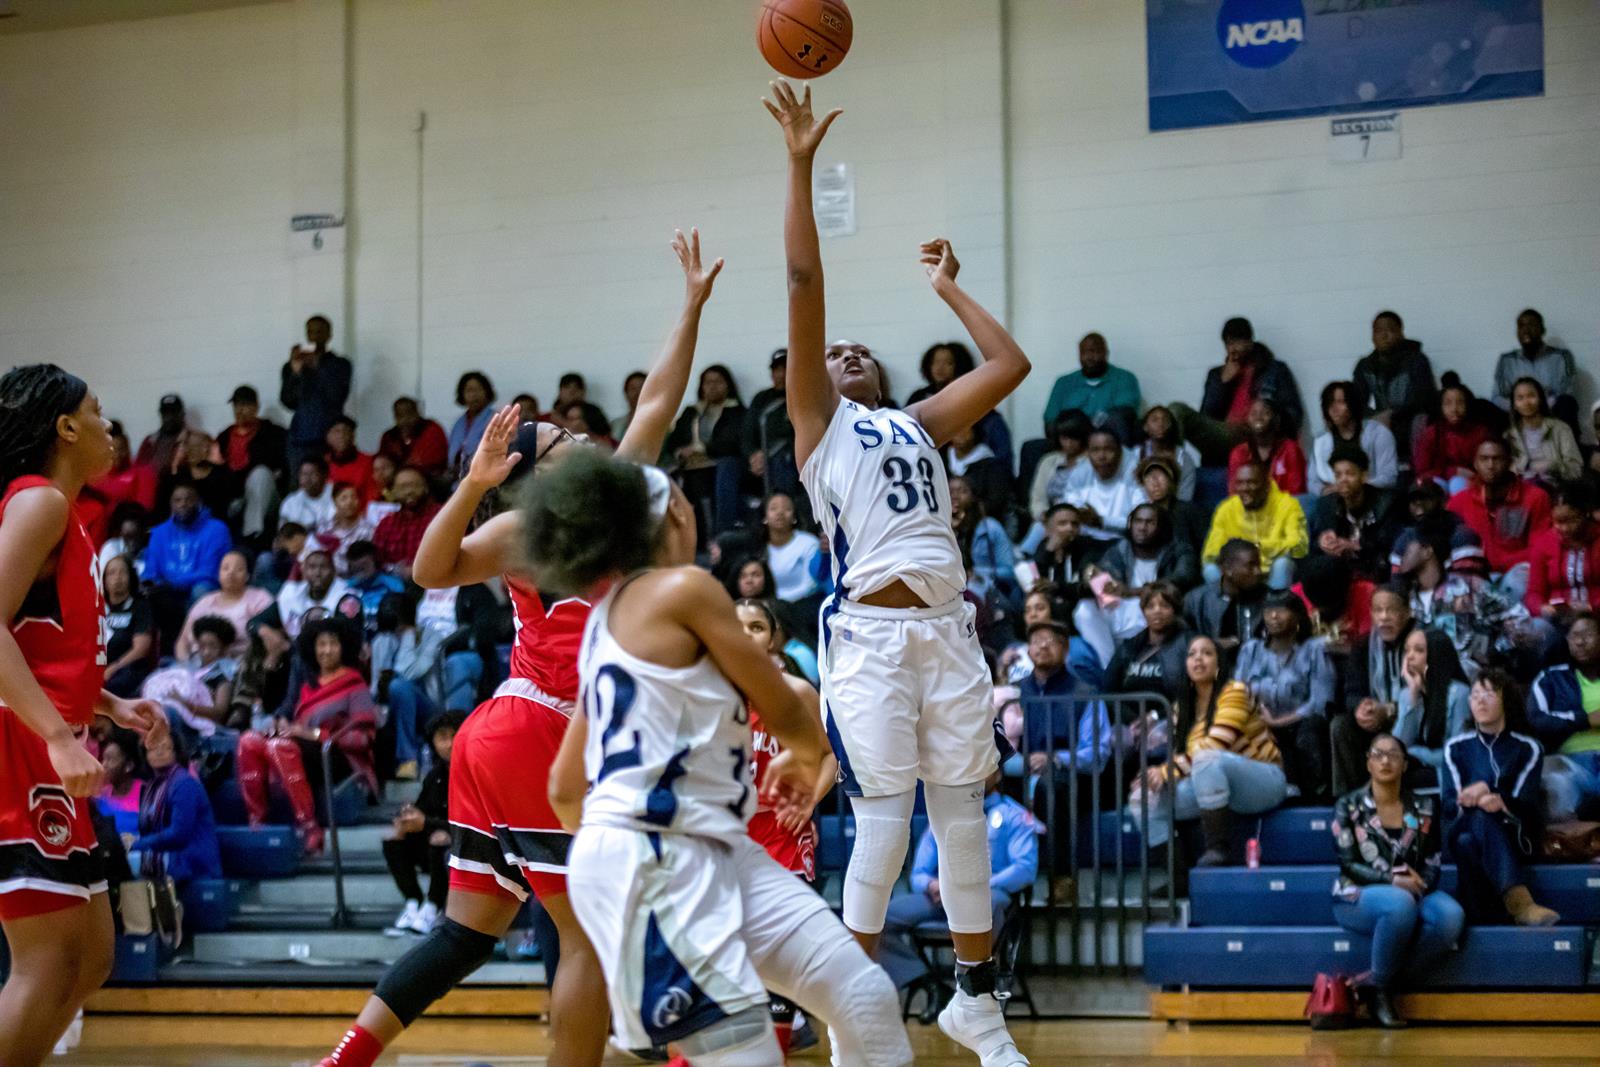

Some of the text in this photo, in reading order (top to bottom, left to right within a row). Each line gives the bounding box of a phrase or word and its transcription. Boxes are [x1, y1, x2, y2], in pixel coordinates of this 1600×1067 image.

[1226, 18, 1304, 49] NCAA
[1359, 135, 1371, 159] 7
[312, 230, 323, 251] 6
[882, 456, 939, 513] 33
